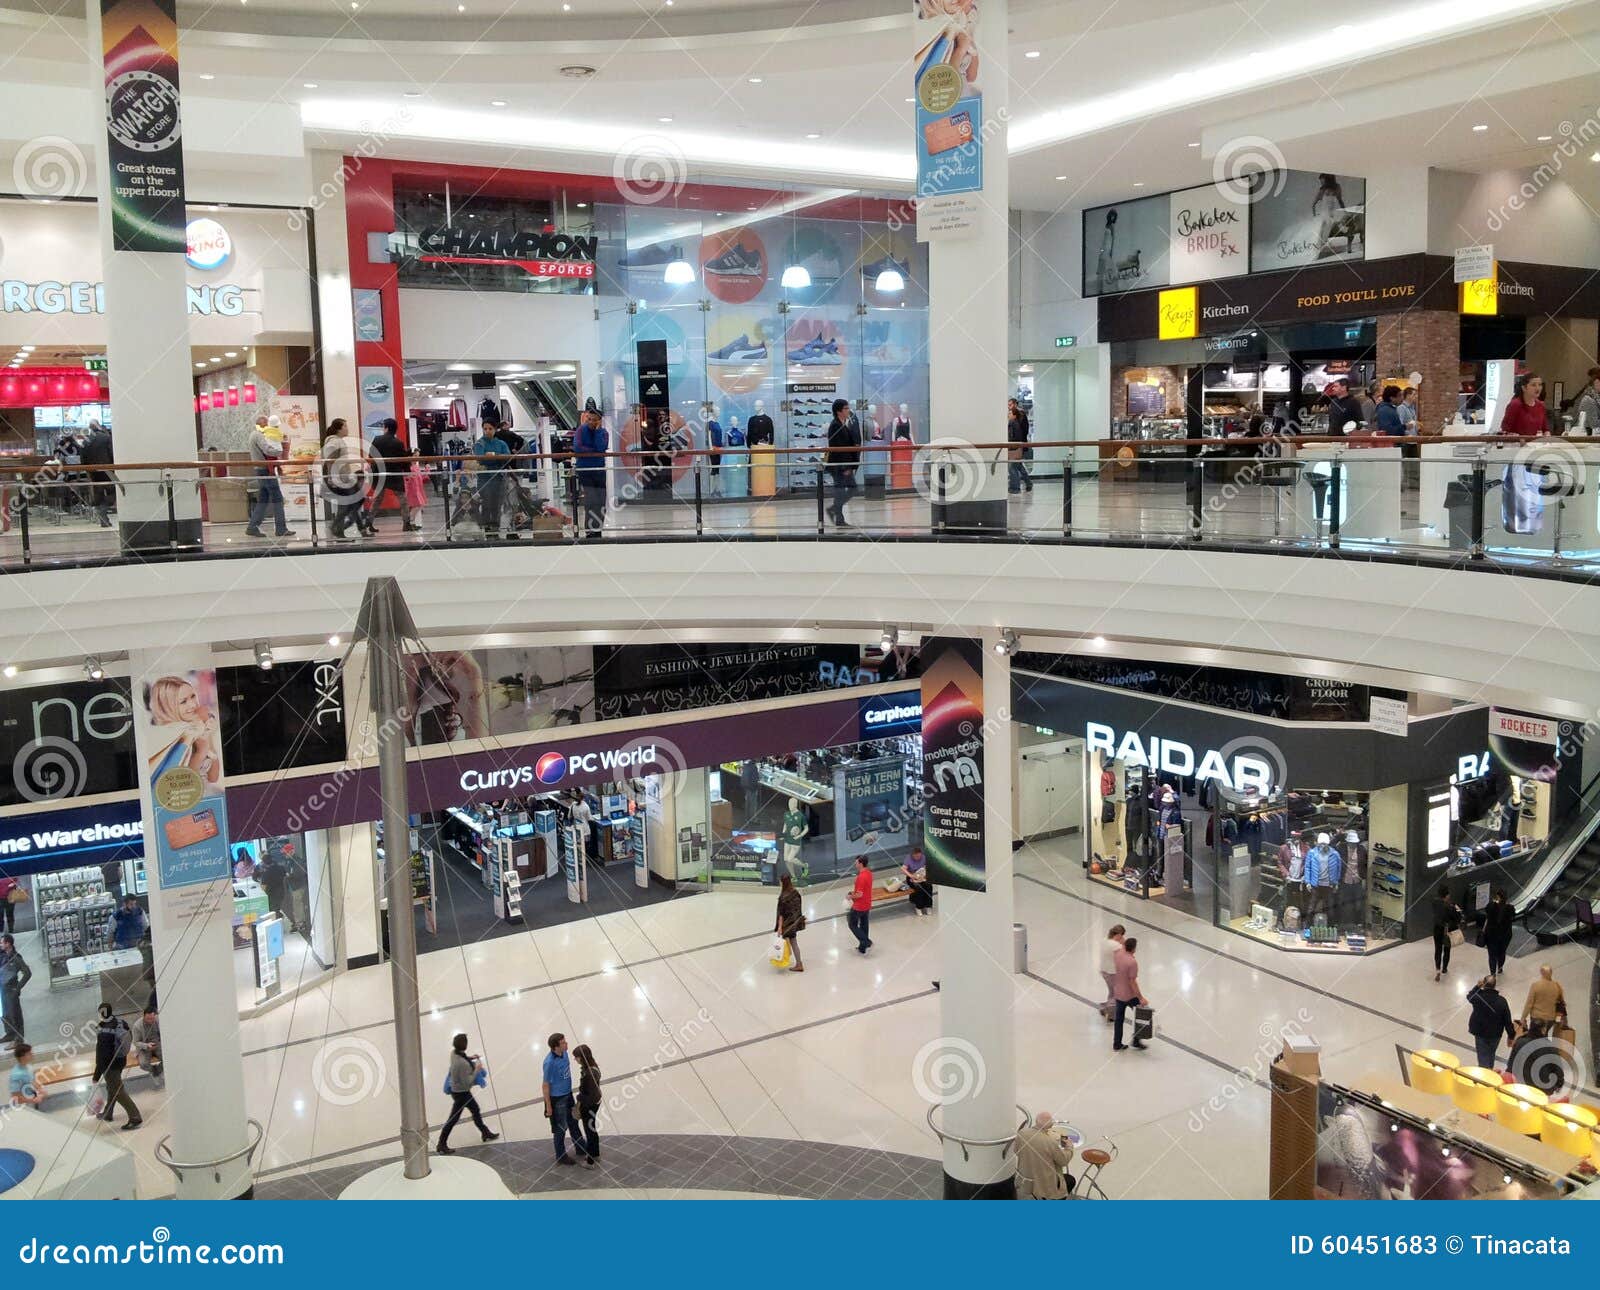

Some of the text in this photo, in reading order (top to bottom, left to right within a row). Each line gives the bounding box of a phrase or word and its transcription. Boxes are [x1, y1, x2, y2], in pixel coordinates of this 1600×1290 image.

[120, 87, 137, 104] THE
[107, 80, 179, 143] WATCH
[146, 114, 173, 140] STORE
[117, 163, 176, 176] Great stores
[131, 175, 164, 186] on the
[116, 186, 180, 198] upper floors!
[417, 226, 598, 260] CHAMPION
[1187, 232, 1227, 255] BRIDE
[539, 263, 593, 275] SPORTS
[3, 280, 244, 316] RGE NG
[1297, 285, 1416, 308] FOOD YOU'LL LOVE
[1497, 282, 1534, 296] Kitchen
[1203, 304, 1249, 319] Kitchen
[1204, 337, 1249, 351] welcome
[646, 646, 817, 675] FASHION JEWELLERY GIFT
[313, 660, 342, 726] ext
[1305, 679, 1353, 688] GROUND
[1311, 688, 1349, 698] FLOOR
[31, 692, 132, 746] ne
[1500, 717, 1548, 736] ROCKET'S
[924, 740, 980, 761] mothercare
[1087, 721, 1271, 797] RAIDAR
[460, 744, 656, 792] Currys PC World
[847, 769, 901, 788] NEW TERM
[850, 781, 899, 798] FOR LESS
[930, 805, 978, 820] Great stores
[940, 818, 968, 828] on the
[32, 820, 144, 849] Warehous
[929, 826, 980, 841] upper floors!
